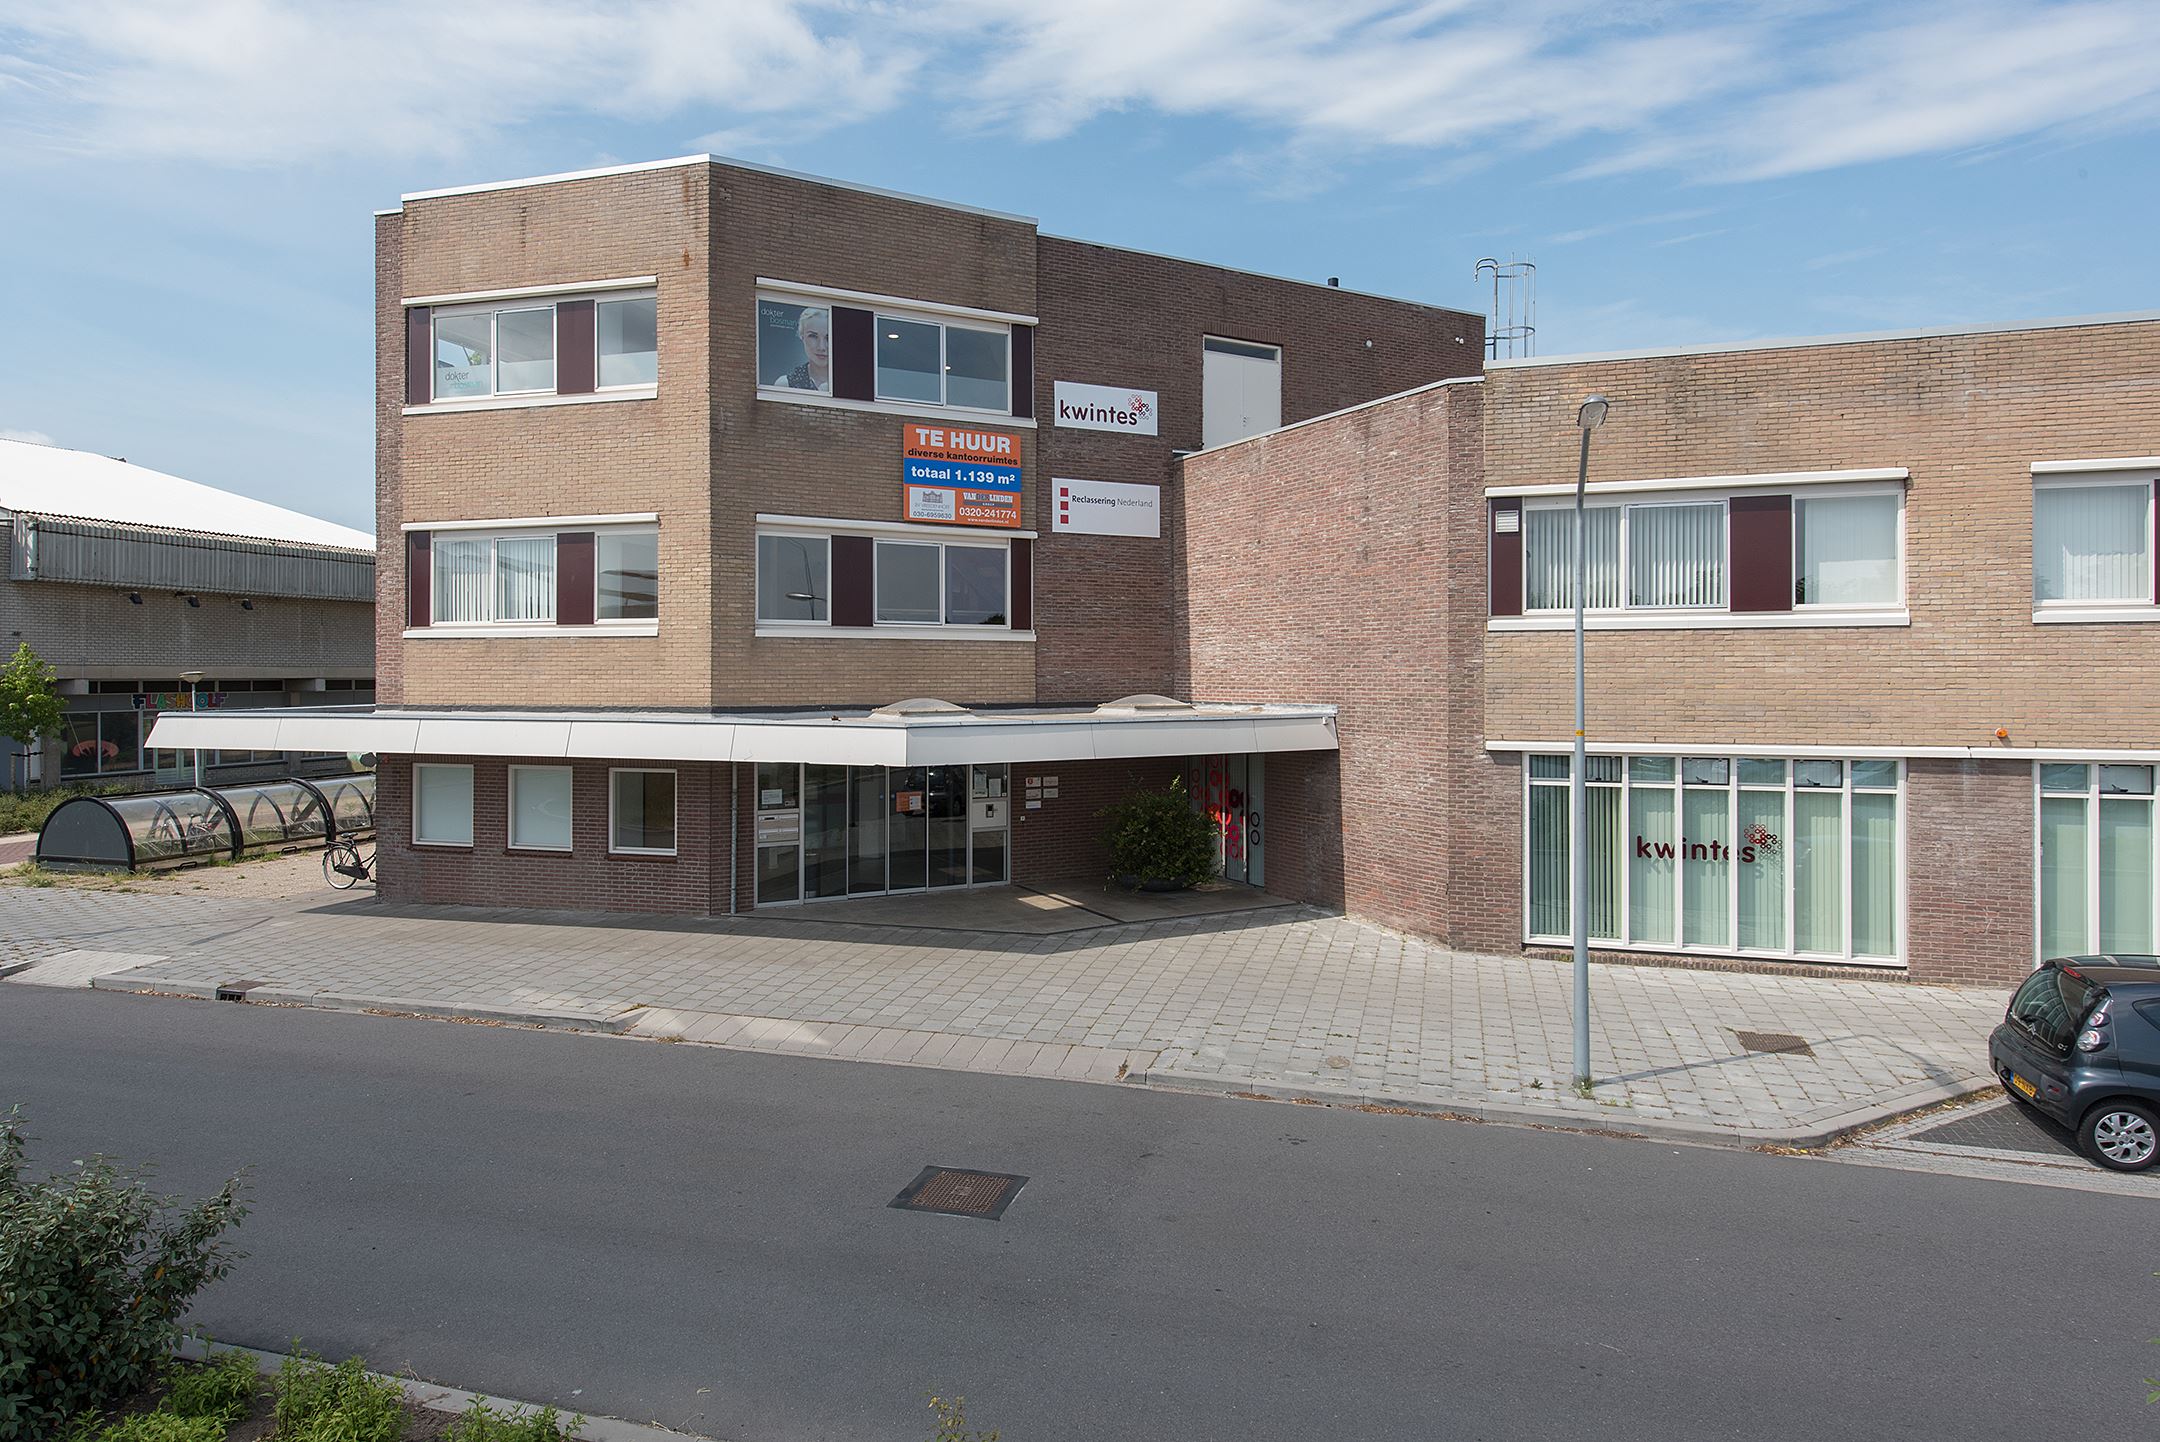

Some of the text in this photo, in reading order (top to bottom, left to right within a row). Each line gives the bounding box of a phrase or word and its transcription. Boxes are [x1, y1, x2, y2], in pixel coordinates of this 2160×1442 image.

[445, 371, 469, 382] dokter
[1060, 399, 1138, 425] kwintes
[916, 428, 1011, 454] TE HUUR
[908, 448, 1018, 466] diverse kantoorruimtes
[911, 466, 950, 480] totaal
[955, 470, 994, 483] 1.139
[1072, 495, 1153, 508] Reclassering Nederland
[959, 507, 1017, 520] 0320-241774
[1637, 835, 1756, 863] kwintes
